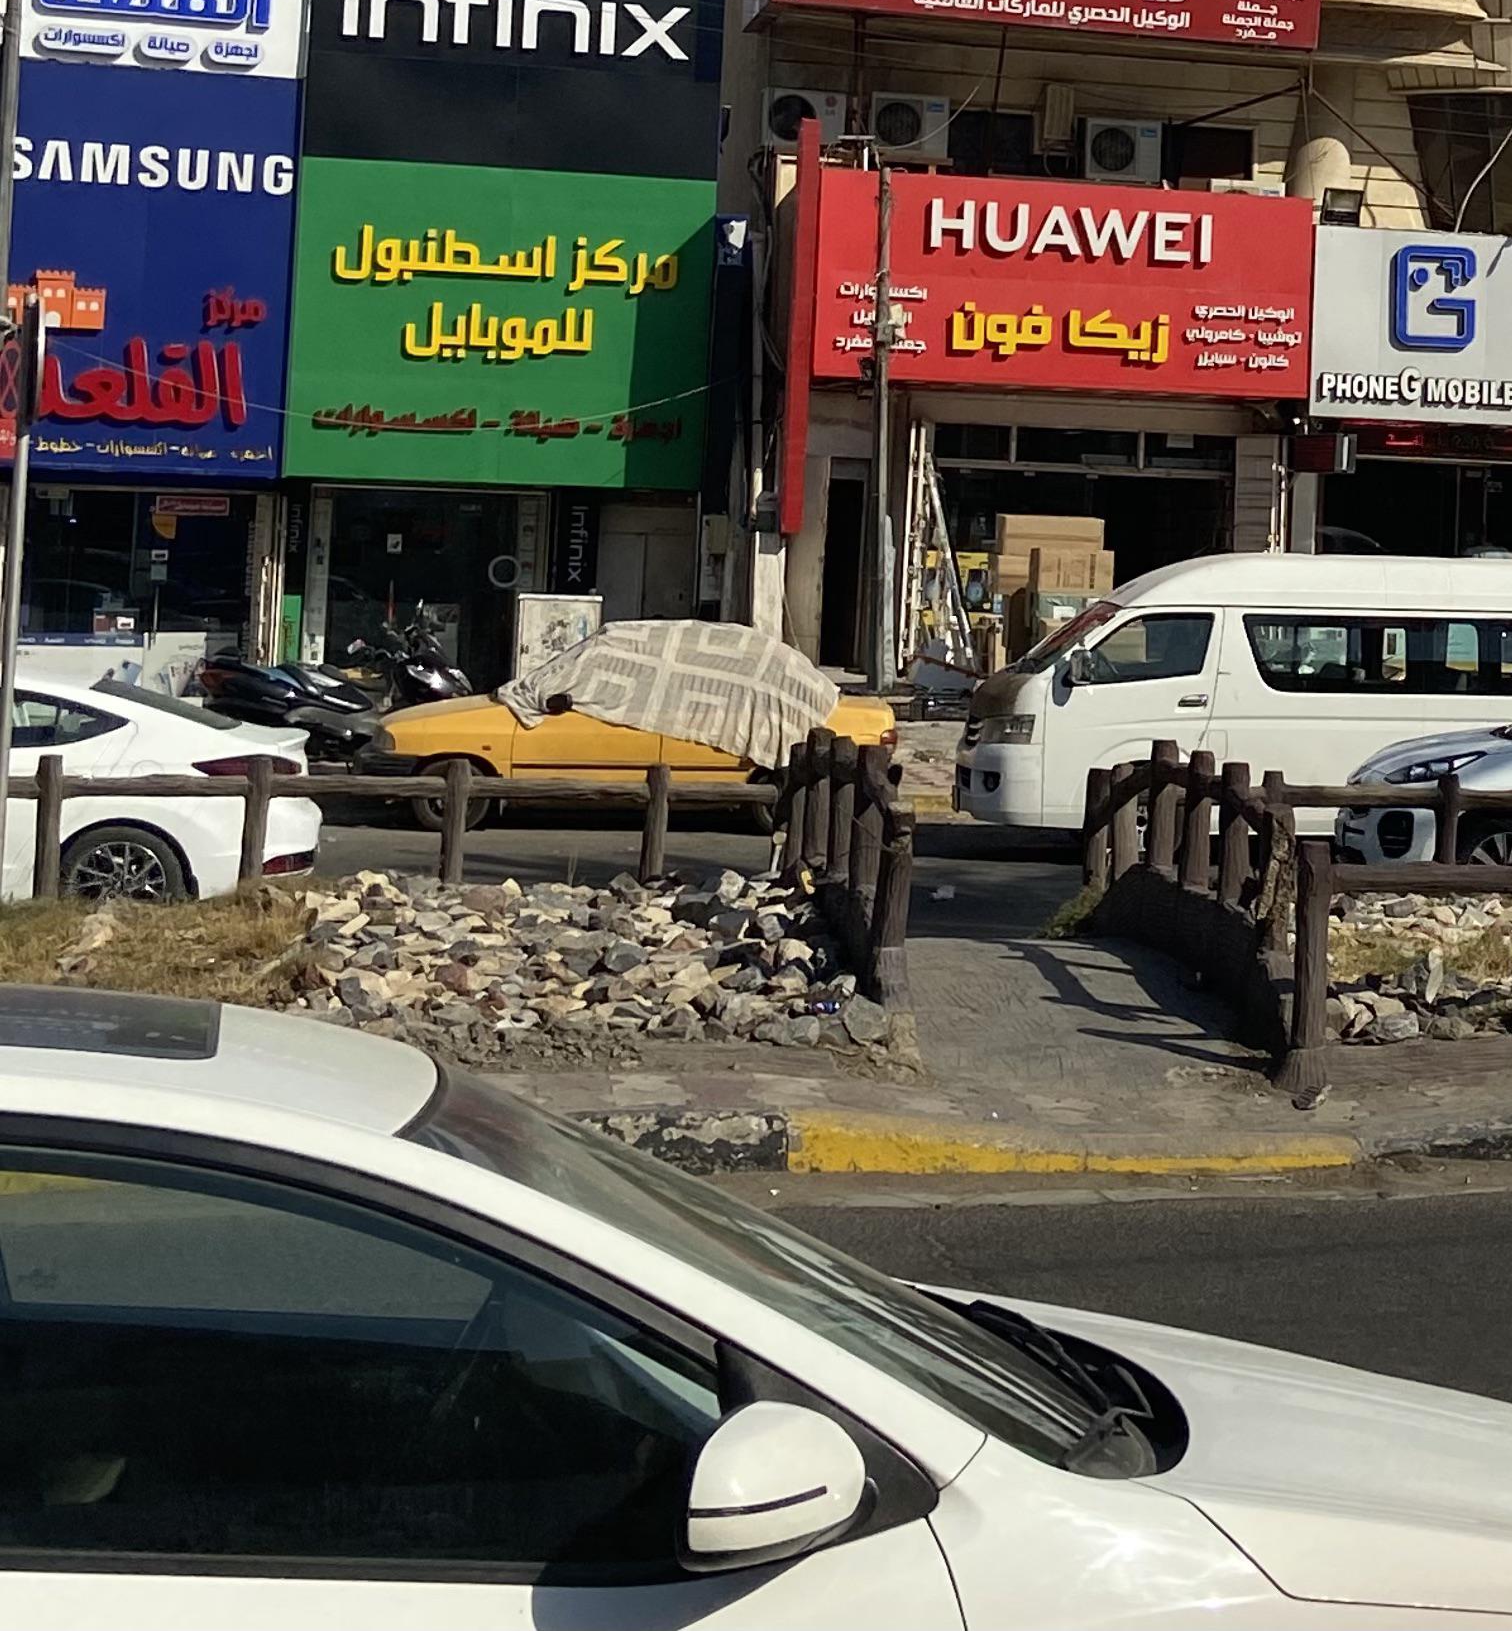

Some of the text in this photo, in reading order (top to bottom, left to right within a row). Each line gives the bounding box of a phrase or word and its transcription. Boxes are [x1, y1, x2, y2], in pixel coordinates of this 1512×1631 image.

[1068, 3, 1130, 25] الحصري
[1133, 8, 1190, 30] الوكيل
[1237, 0, 1278, 15] جملة
[43, 27, 258, 59] اجهزة صيانة اكسسوارات
[1235, 28, 1277, 39] مفرد
[12, 136, 294, 195] SAMSUNG
[929, 198, 1213, 263] HUAWEI
[336, 225, 678, 294] مركز اسطنبول
[206, 285, 267, 327] مركز
[1195, 306, 1295, 323] الوكيل الحصري
[405, 301, 594, 360] للموبايل
[952, 301, 1170, 363] زيكا فون
[1248, 353, 1289, 370] كانون
[567, 506, 590, 584] Infinix
